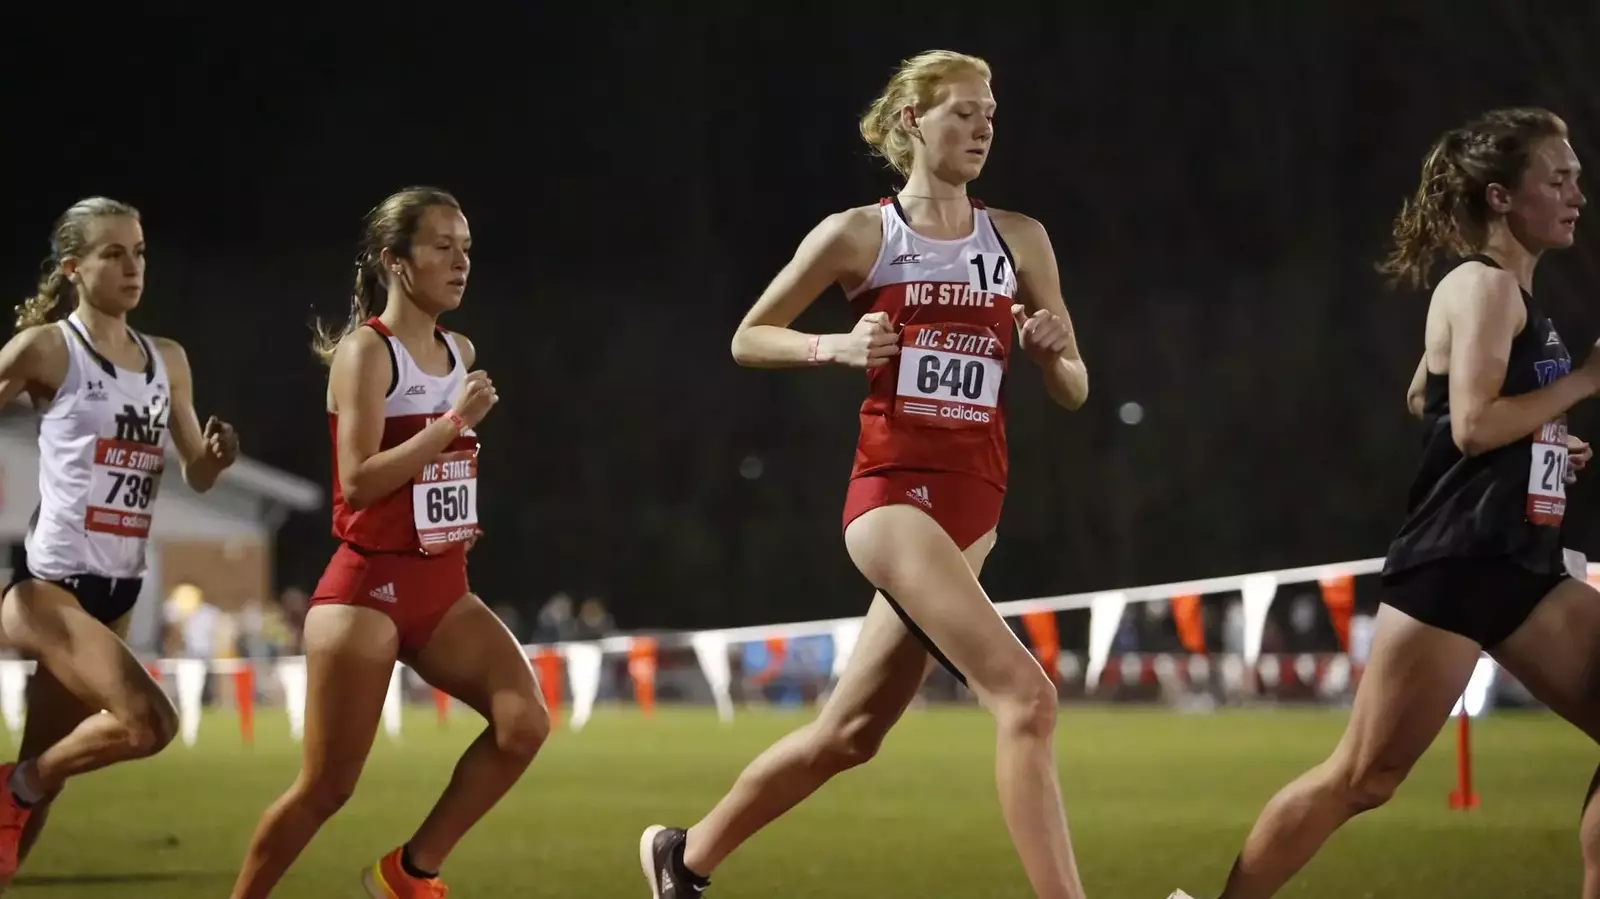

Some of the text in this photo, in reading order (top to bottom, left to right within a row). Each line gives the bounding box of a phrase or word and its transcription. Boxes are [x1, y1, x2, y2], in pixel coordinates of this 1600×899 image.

[889, 254, 921, 266] ACC
[970, 254, 1006, 291] 14
[905, 283, 995, 308] NC STATE
[915, 328, 997, 356] NC STATE
[916, 354, 985, 400] 640
[404, 385, 426, 395] ACC
[940, 405, 990, 423] adidas
[104, 447, 127, 465] NC
[422, 460, 471, 481] NC STATE
[105, 471, 153, 509] 739
[427, 484, 468, 523] 650
